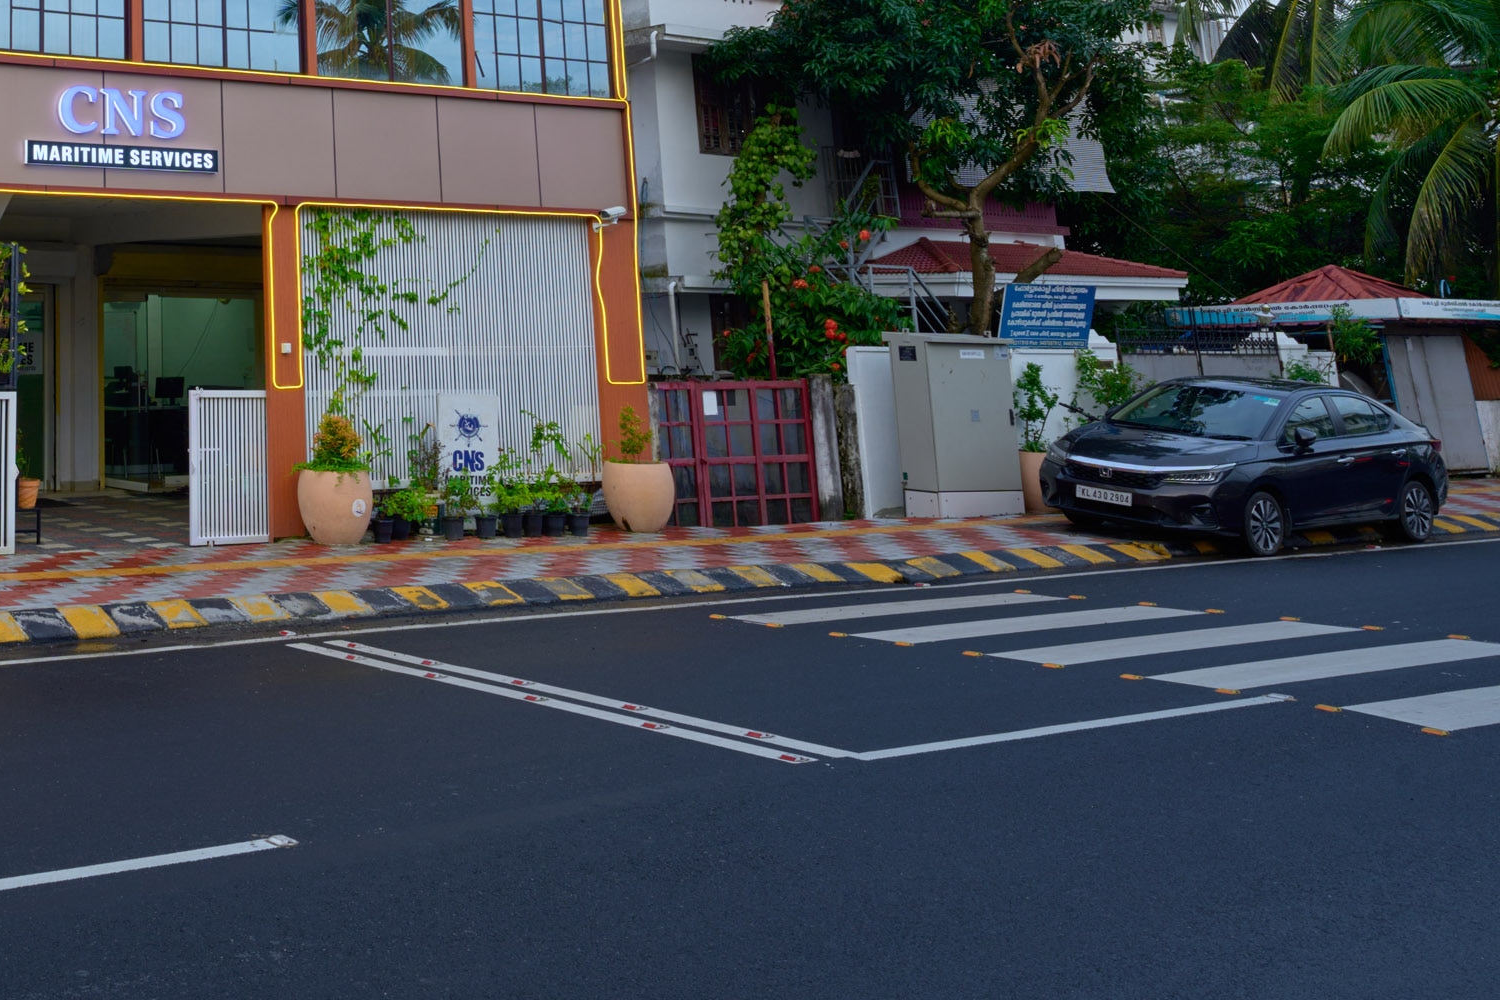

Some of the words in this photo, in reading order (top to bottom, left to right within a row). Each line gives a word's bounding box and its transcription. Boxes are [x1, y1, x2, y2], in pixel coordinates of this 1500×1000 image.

[58, 85, 186, 138] CNS
[33, 144, 124, 164] MARITIME
[130, 149, 214, 169] SERVICES
[453, 450, 484, 472] CNS
[445, 475, 493, 485] MRTIM
[1081, 488, 1090, 497] KL
[1093, 490, 1102, 499] 43
[1110, 493, 1129, 503] 2904
